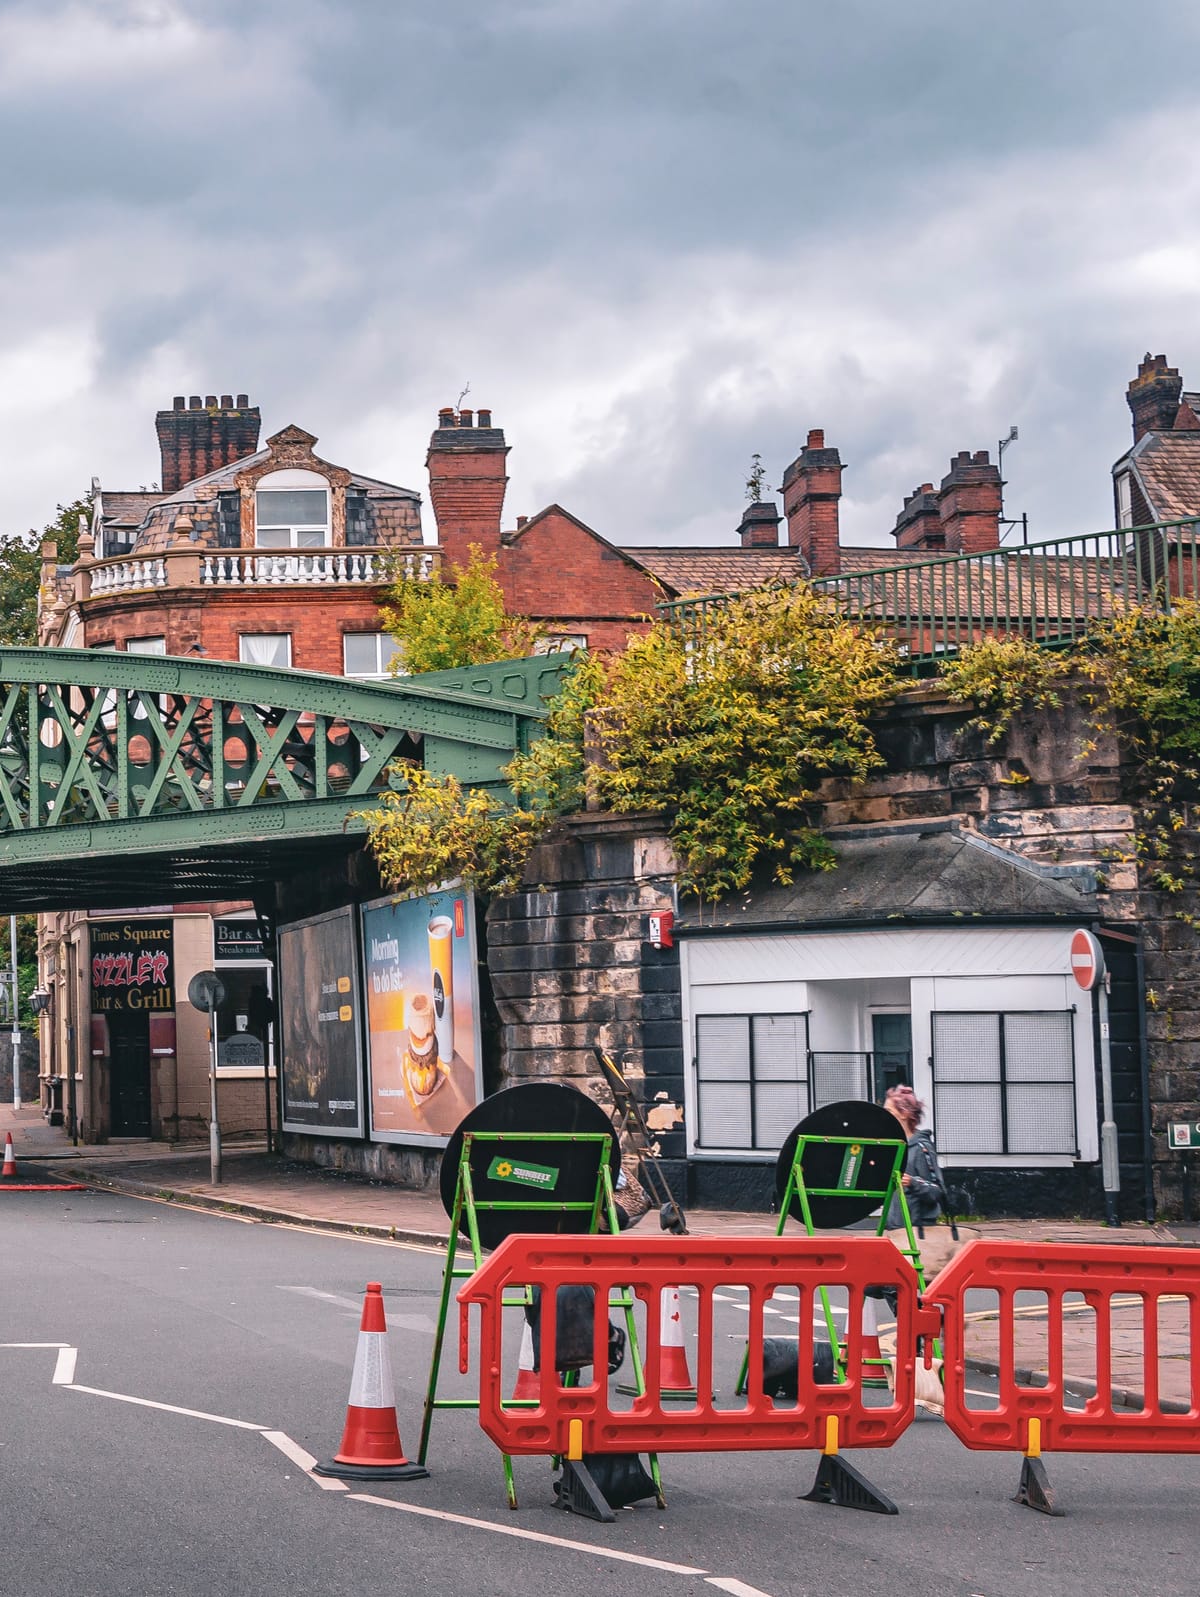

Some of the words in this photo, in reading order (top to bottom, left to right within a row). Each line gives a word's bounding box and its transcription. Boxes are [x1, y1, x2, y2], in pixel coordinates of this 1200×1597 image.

[92, 927, 120, 942] Times
[123, 925, 171, 945] Square
[218, 926, 242, 940] Bar
[245, 931, 253, 939] &
[218, 945, 243, 954] Steaks
[245, 945, 260, 954] and
[371, 933, 399, 965] Morning
[92, 950, 169, 987] SIZZLER
[373, 971, 380, 993] to
[381, 967, 390, 993] do
[92, 989, 112, 1009] Bar
[114, 998, 123, 1009] &
[127, 987, 172, 1009] Grill
[513, 1167, 552, 1182] SUNBELT
